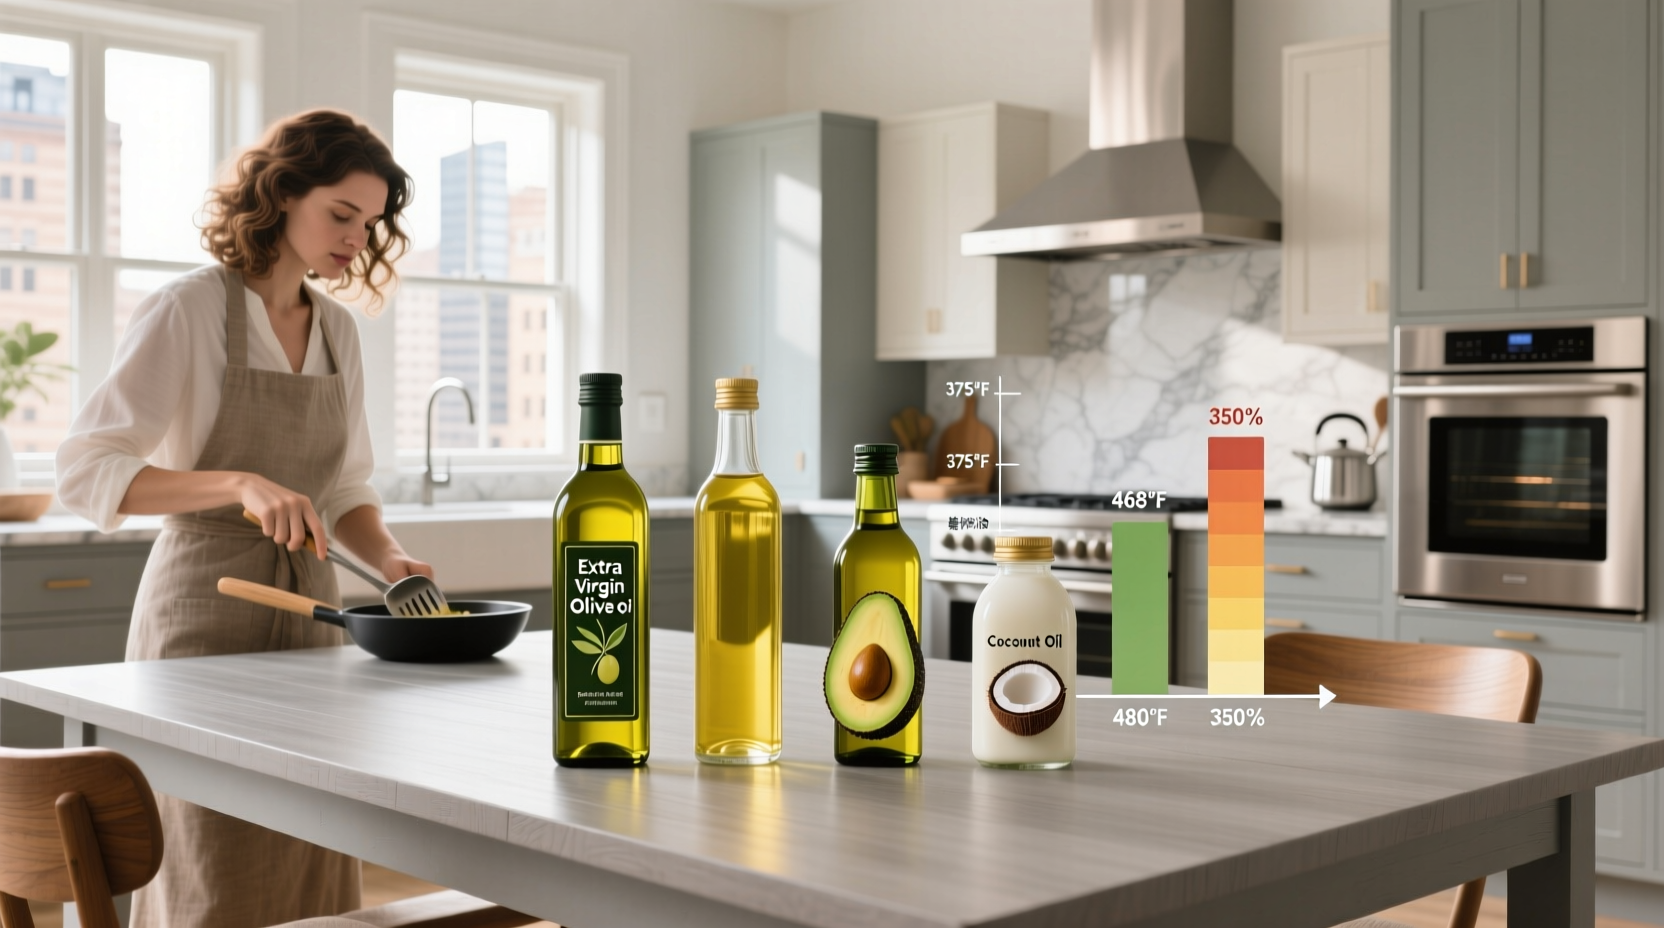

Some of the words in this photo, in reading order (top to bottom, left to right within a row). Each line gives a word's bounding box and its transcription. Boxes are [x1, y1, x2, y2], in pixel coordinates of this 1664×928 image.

[578, 558, 622, 574] Extra
[574, 577, 624, 598] Virgin
[570, 596, 614, 614] Olive
[987, 634, 1040, 648] Coconut
[1045, 633, 1063, 649] Oil
